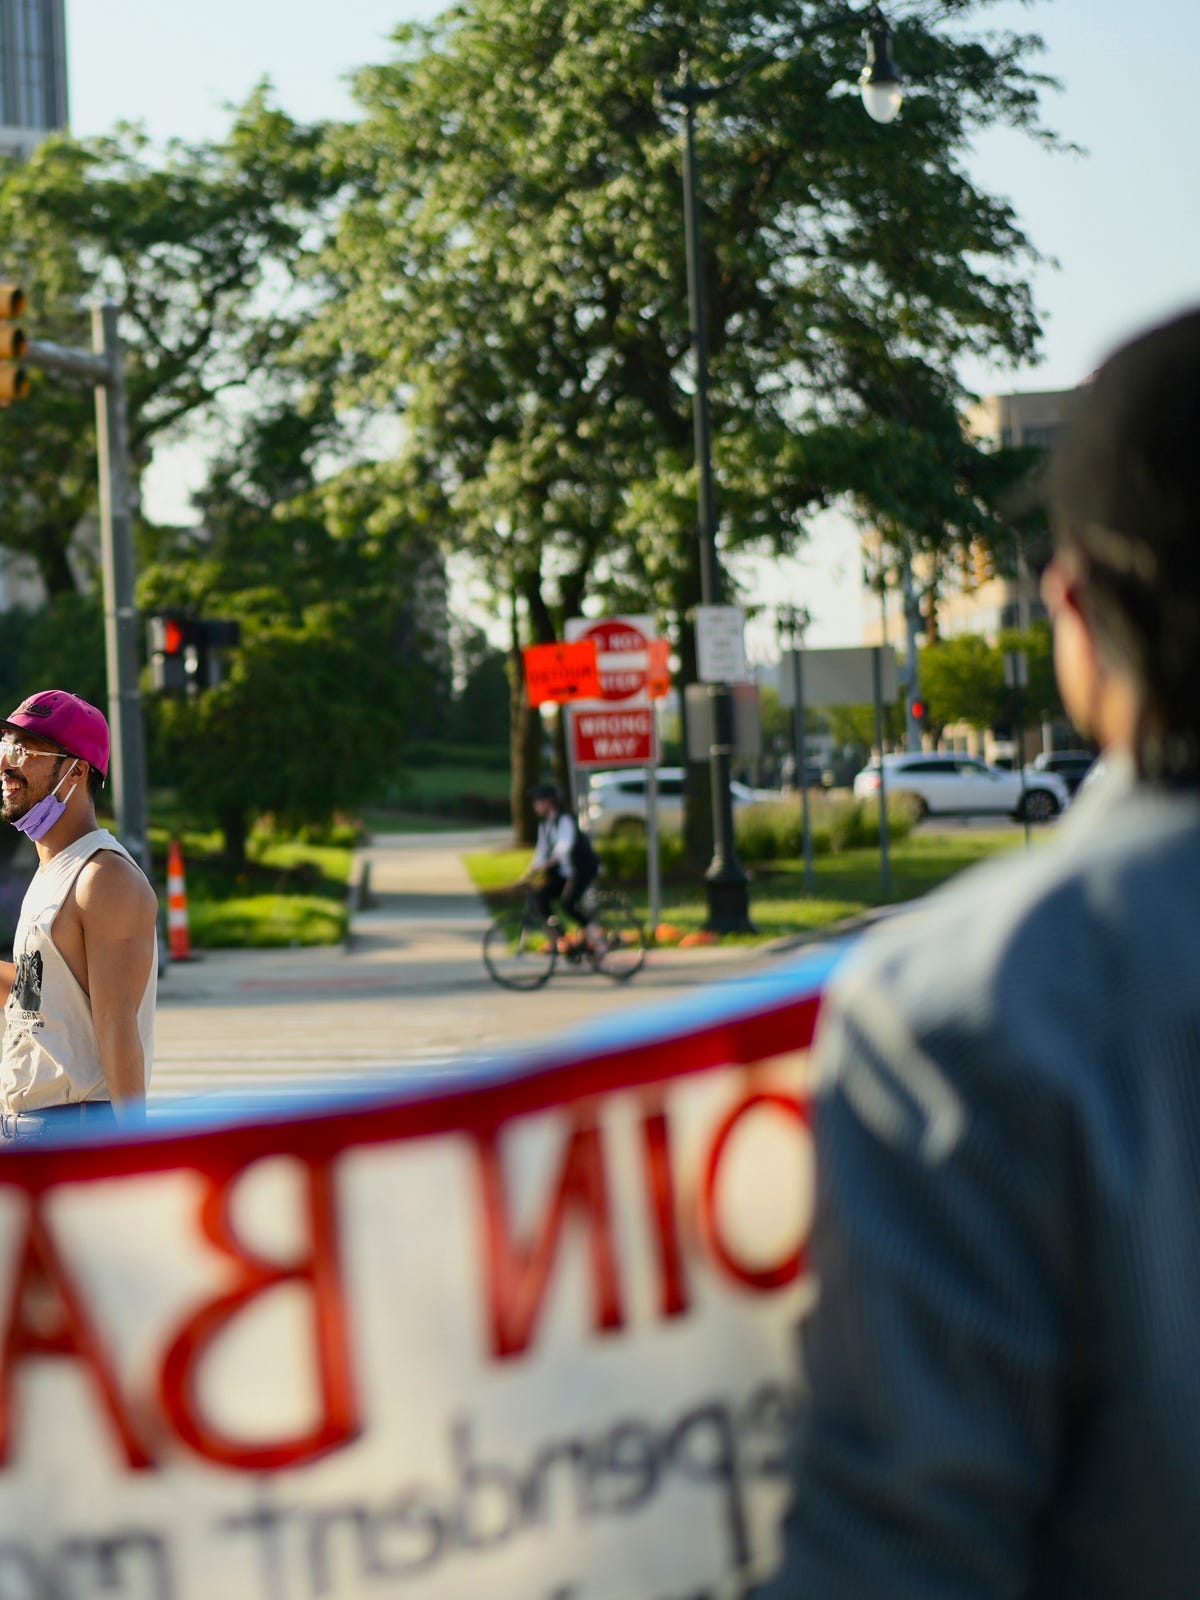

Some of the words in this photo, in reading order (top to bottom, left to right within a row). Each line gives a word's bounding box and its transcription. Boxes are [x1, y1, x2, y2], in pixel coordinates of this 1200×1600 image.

[608, 632, 643, 650] NOT
[579, 711, 649, 735] WRONG
[592, 737, 639, 758] WAY
